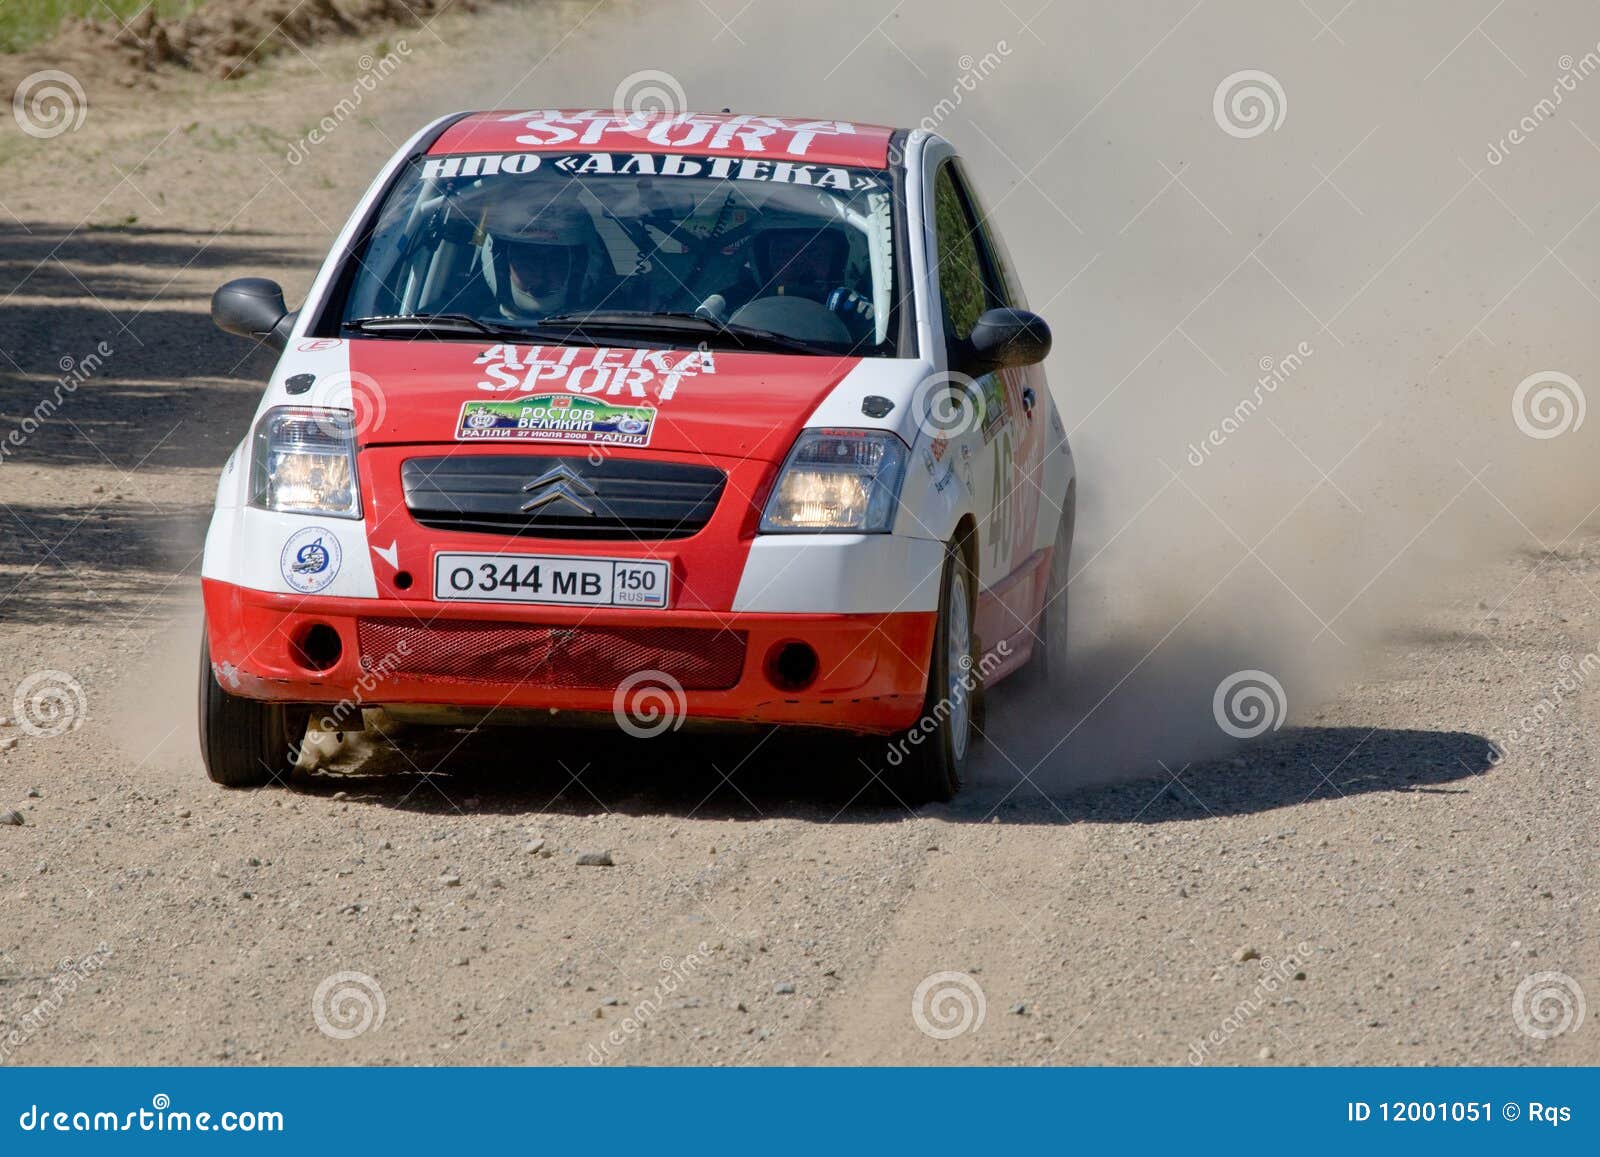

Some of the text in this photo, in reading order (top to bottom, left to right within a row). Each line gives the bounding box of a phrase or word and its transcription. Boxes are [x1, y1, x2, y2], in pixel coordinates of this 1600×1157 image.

[515, 118, 840, 155] SPORT
[420, 153, 542, 179] НПО
[473, 344, 716, 374] ALTEKA
[477, 363, 697, 401] SPORT
[520, 407, 595, 421] РОСТОВ
[462, 429, 511, 437] РАЛЛИ
[594, 433, 643, 444] РАЛЛИ
[616, 568, 656, 591] 150
[619, 592, 643, 602] RUS
